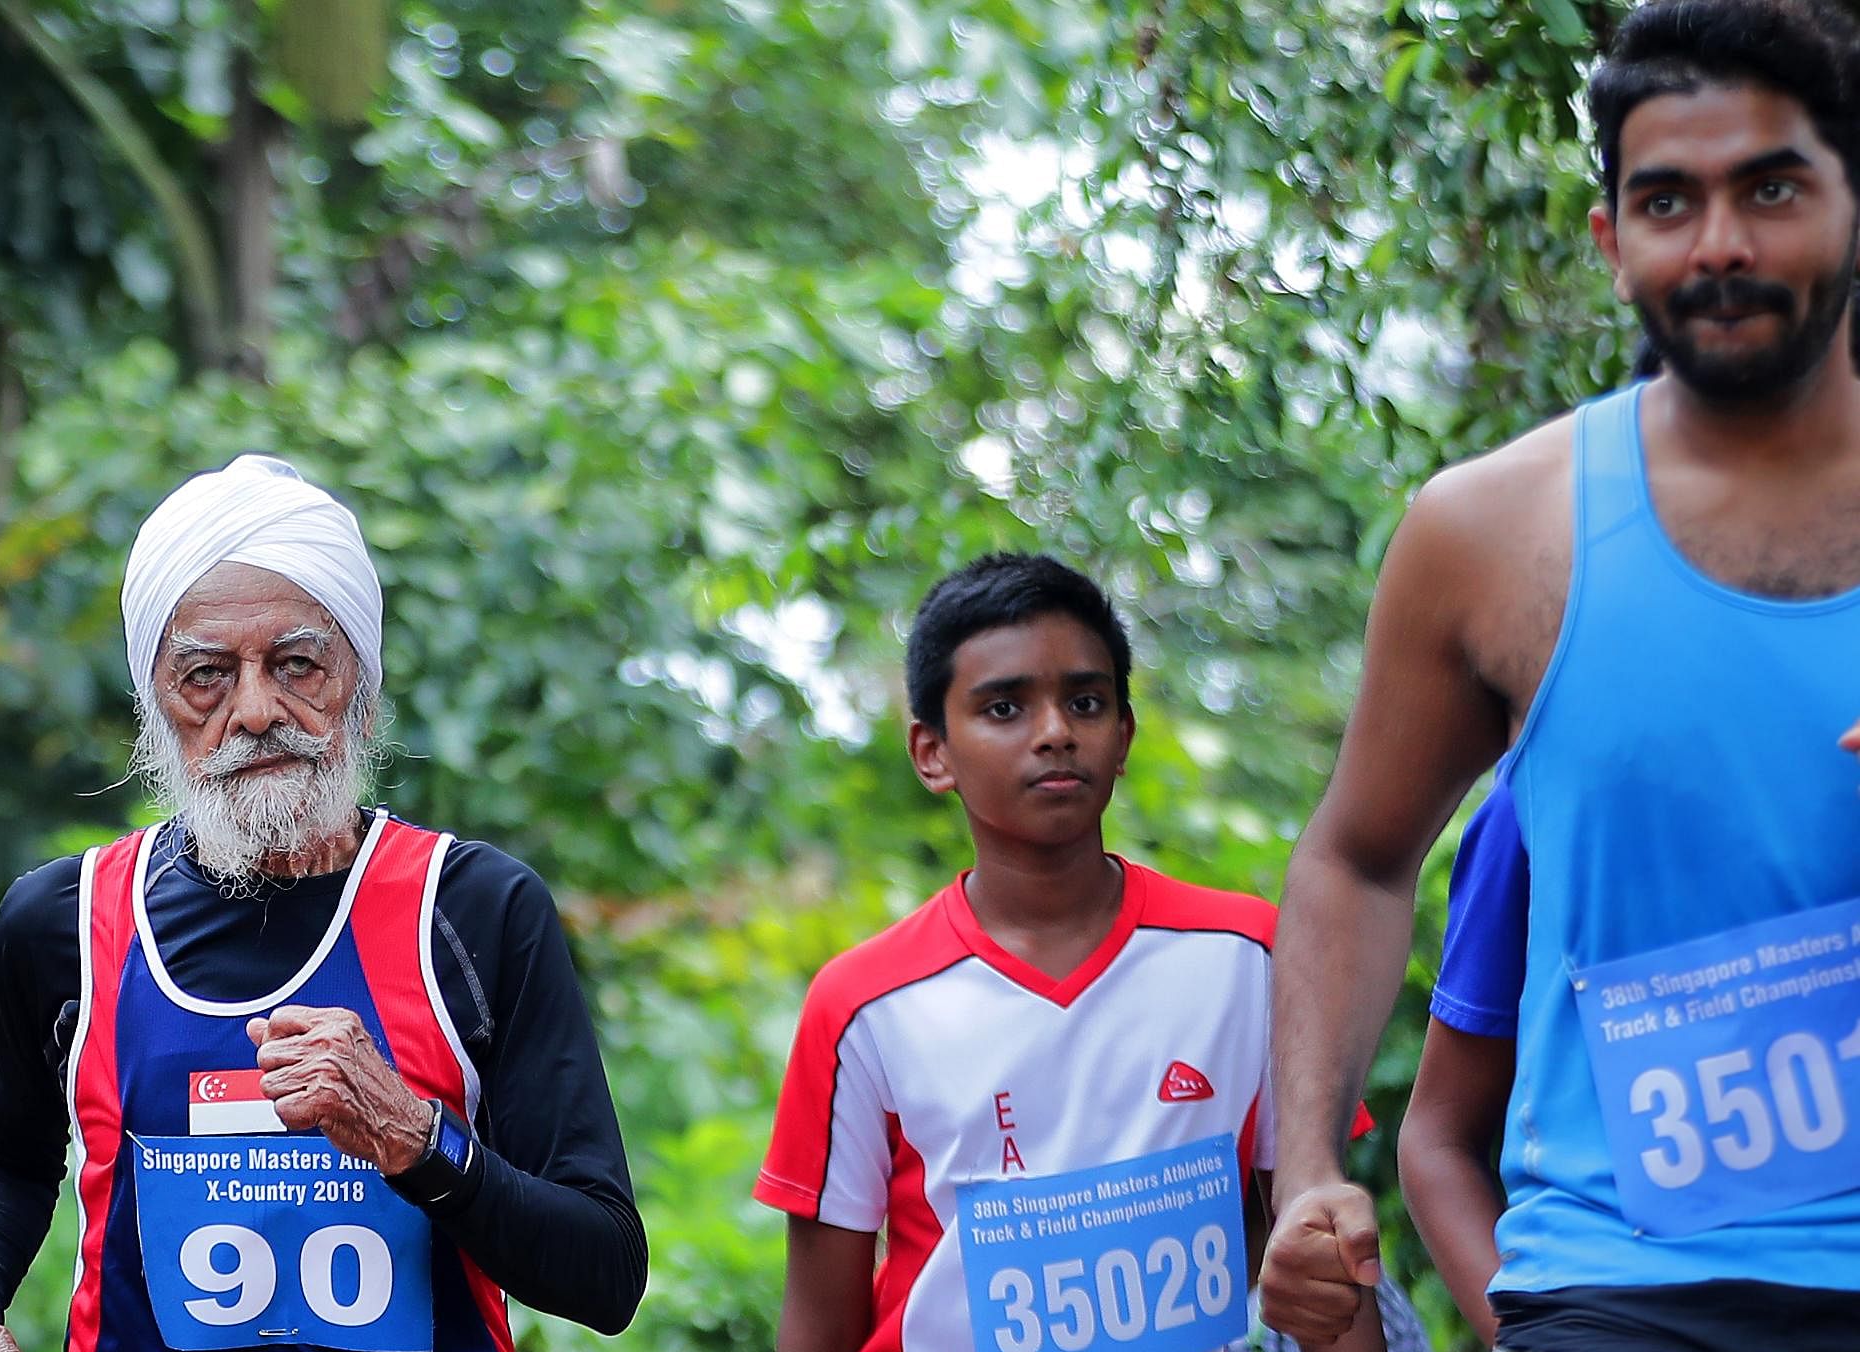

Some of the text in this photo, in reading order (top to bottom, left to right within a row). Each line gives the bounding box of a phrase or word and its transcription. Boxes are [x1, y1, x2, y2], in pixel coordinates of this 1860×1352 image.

[1601, 981, 1648, 1010] 38th
[1650, 956, 1753, 996] Singapore
[1756, 932, 1846, 970] Masters
[1600, 1011, 1659, 1044] Track
[1665, 1006, 1682, 1029] &
[1685, 993, 1736, 1023] Field
[142, 1148, 241, 1174] Singapore
[248, 1149, 332, 1170] Masters
[206, 1179, 365, 1206] X-Country 2018
[973, 1154, 1223, 1220] 38th Singapore Masters Athletics
[972, 1176, 1230, 1245] Track & Field Championships 2017
[179, 1223, 393, 1327] 90
